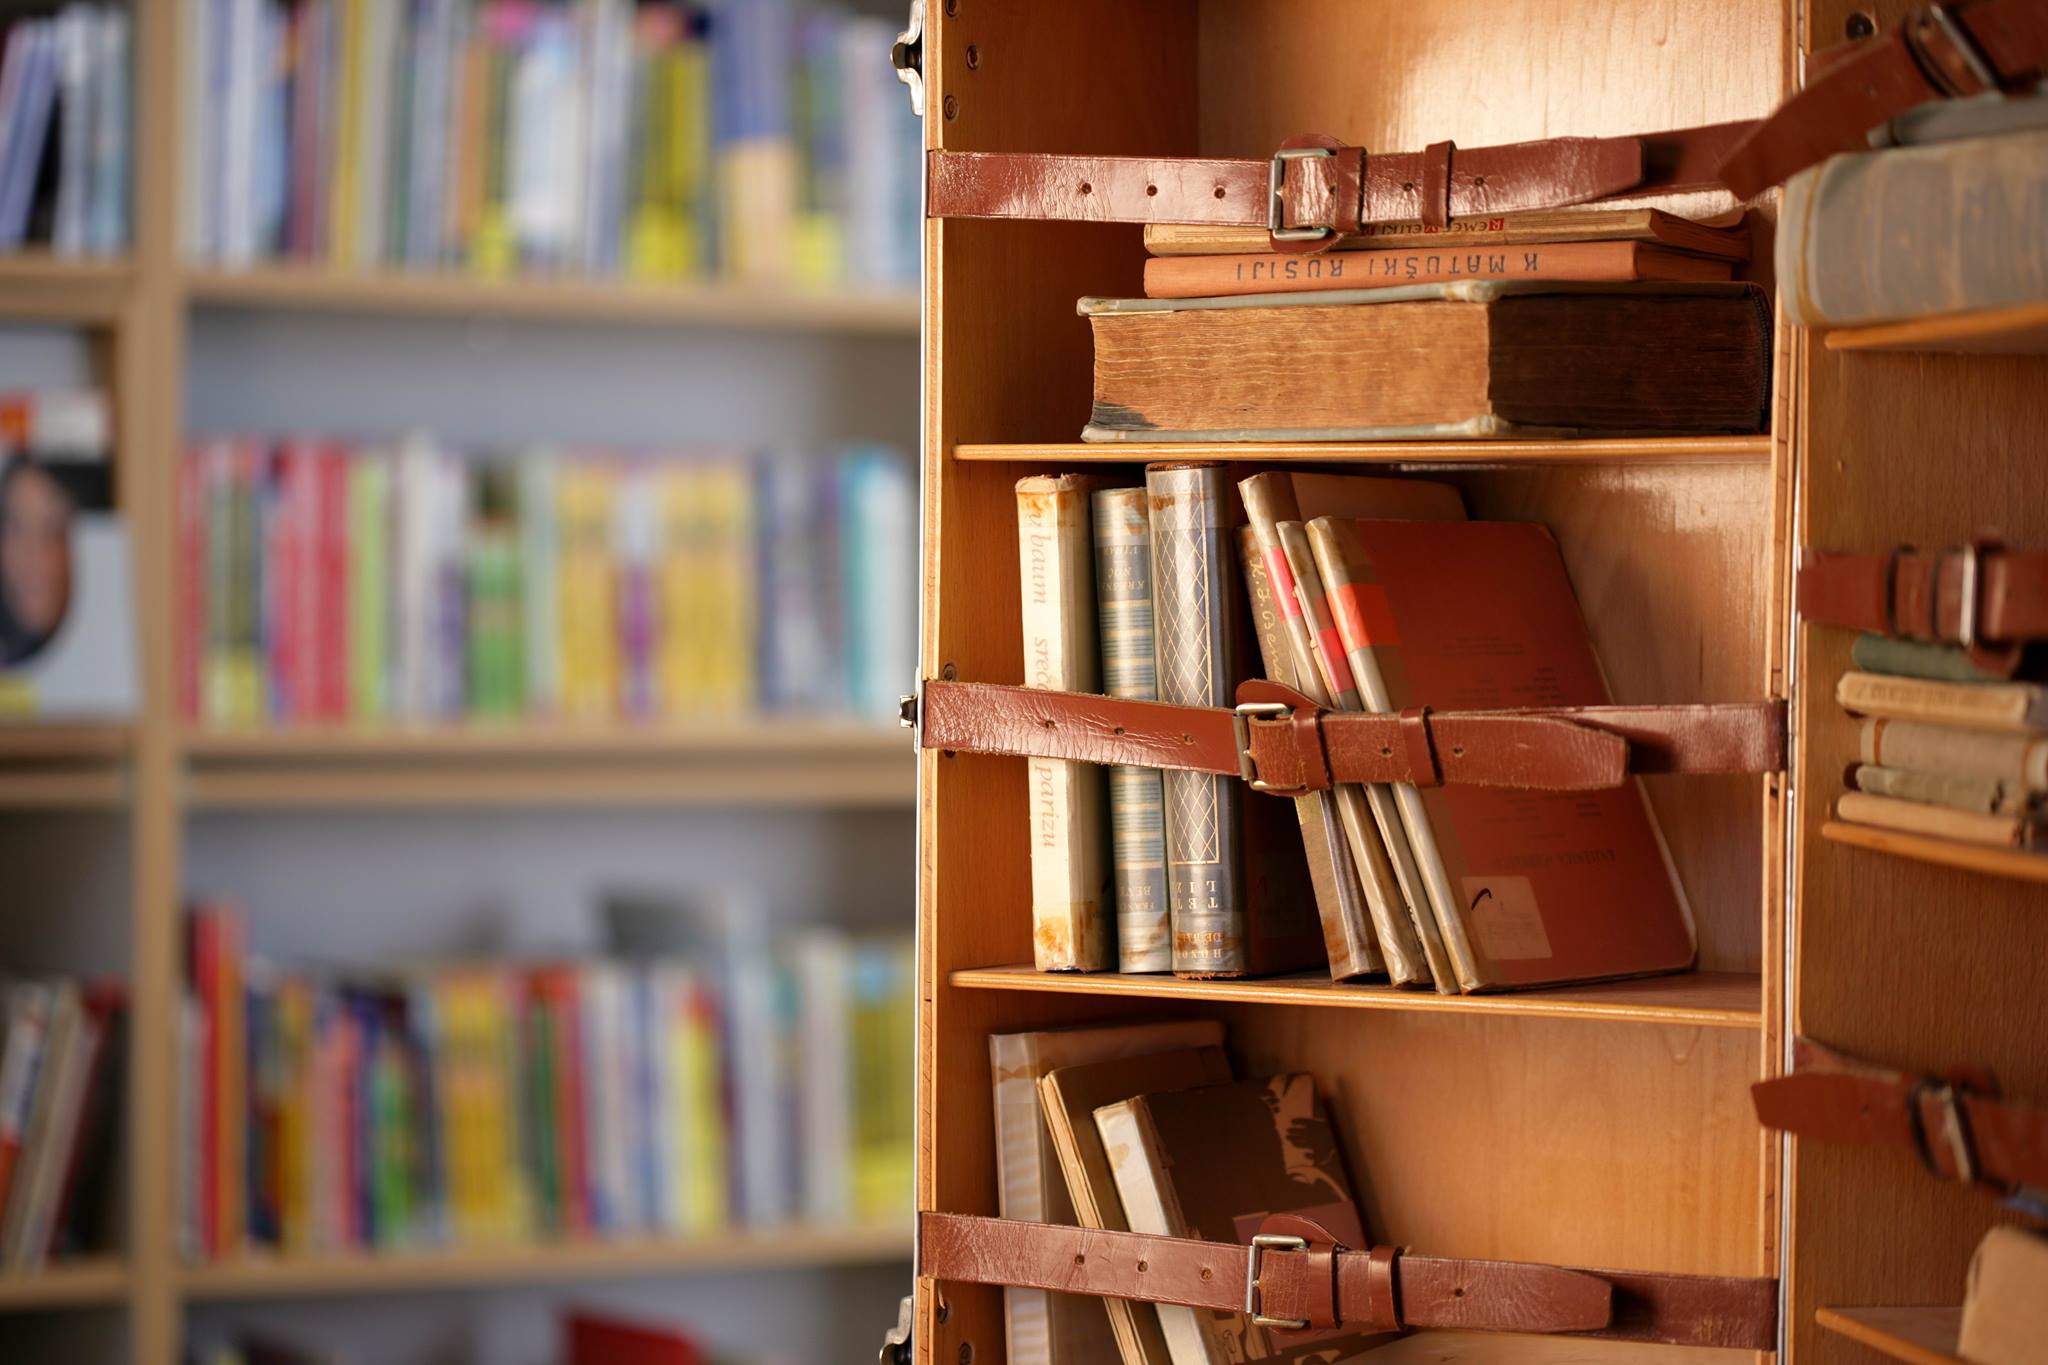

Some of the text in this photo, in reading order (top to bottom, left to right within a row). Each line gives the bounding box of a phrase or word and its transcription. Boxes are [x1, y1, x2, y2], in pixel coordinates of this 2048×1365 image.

[1236, 252, 1539, 281] K MATUŠKI RUSIJI
[1030, 533, 1052, 605] baum
[1034, 763, 1060, 848] parizu
